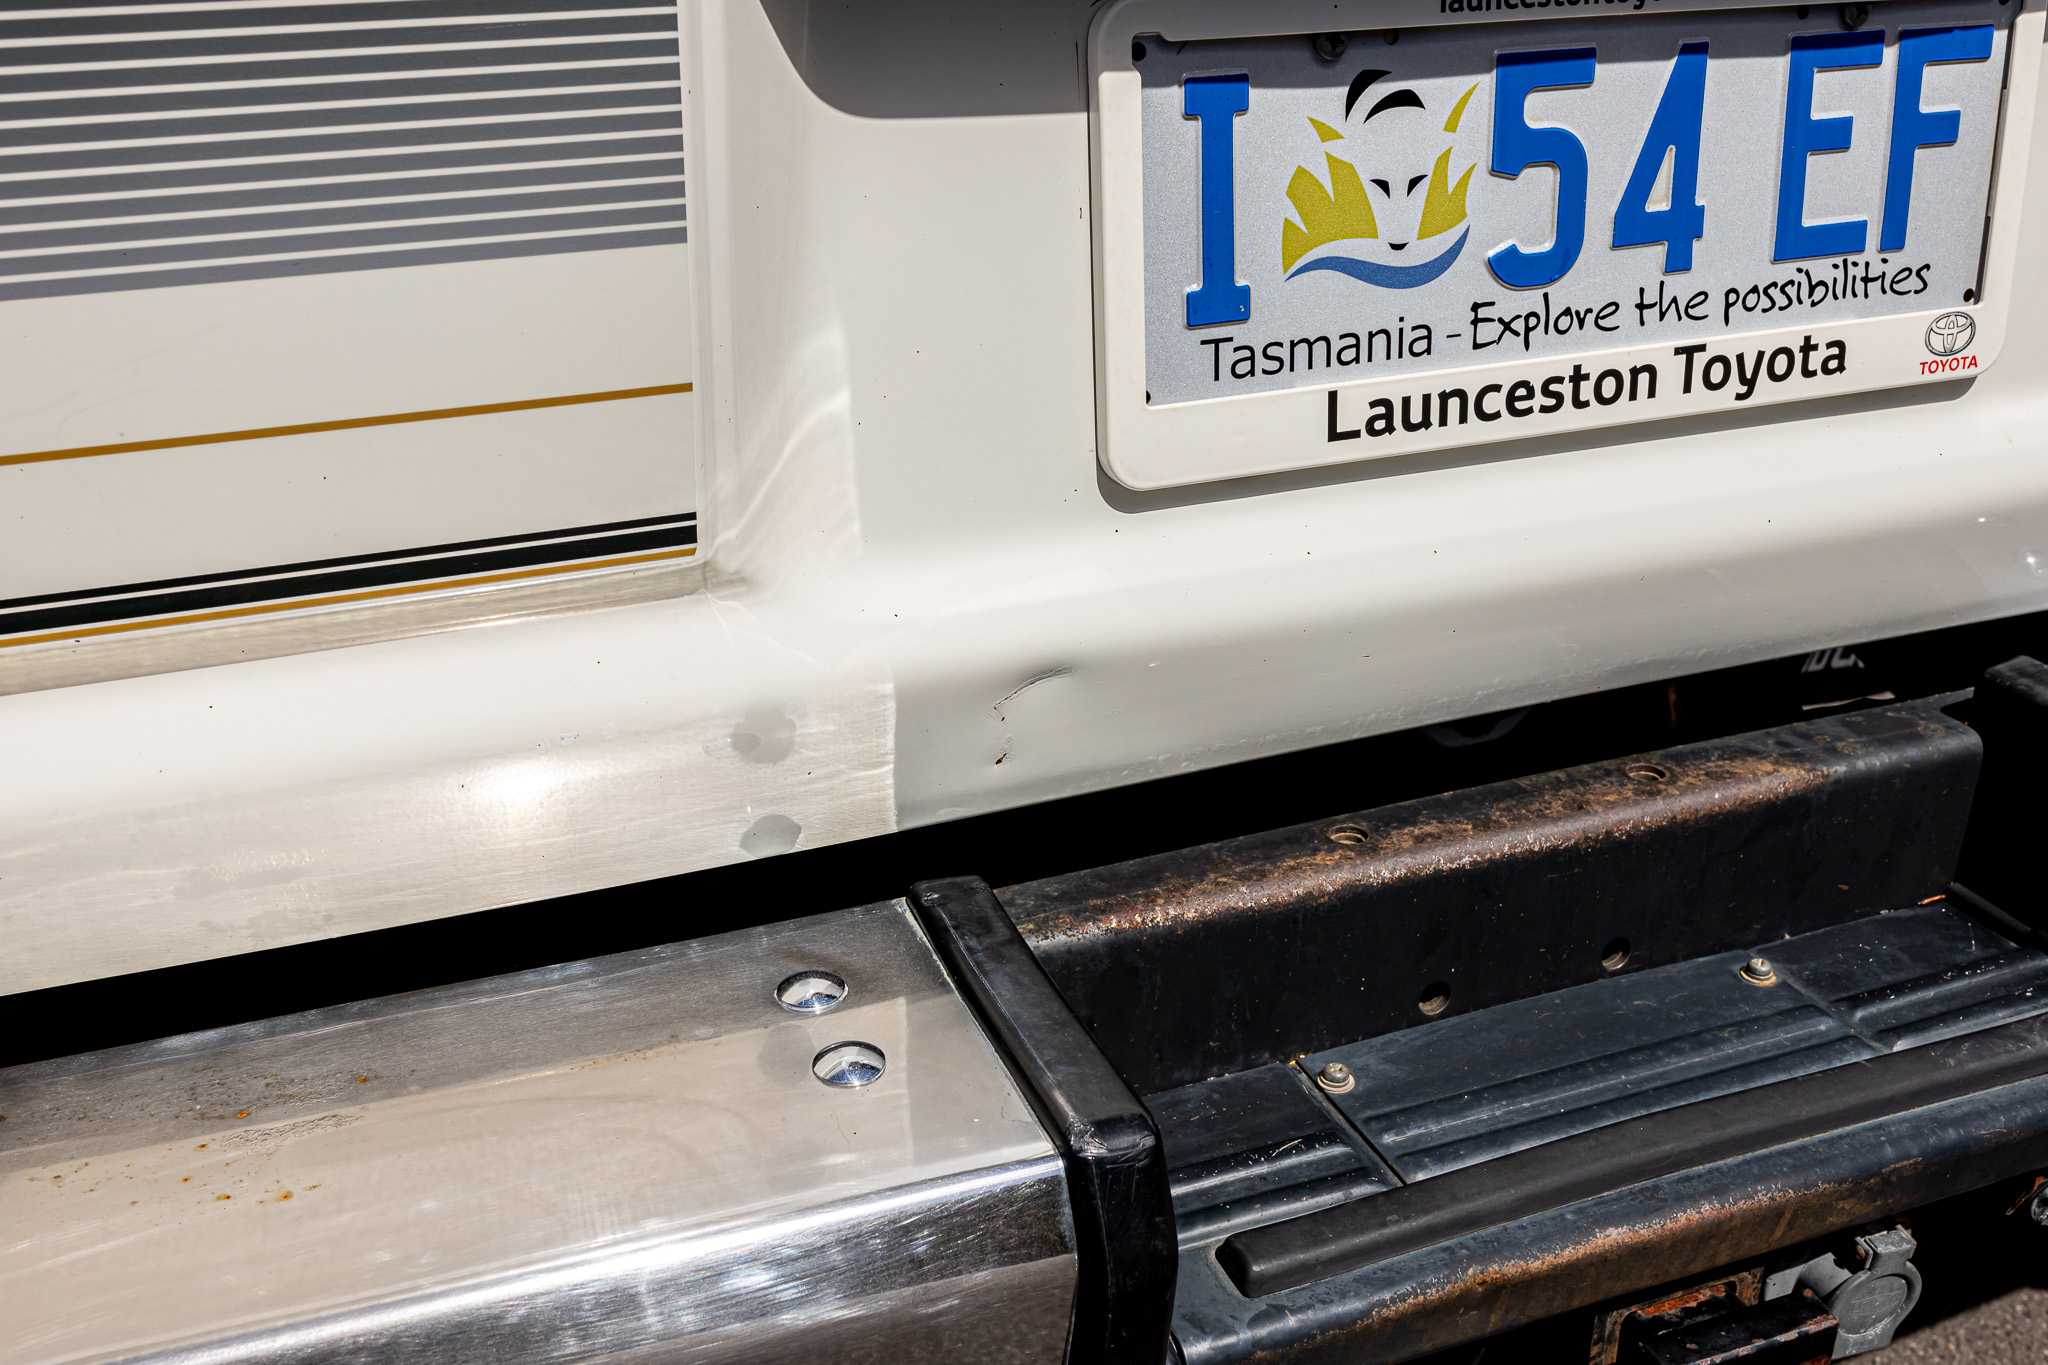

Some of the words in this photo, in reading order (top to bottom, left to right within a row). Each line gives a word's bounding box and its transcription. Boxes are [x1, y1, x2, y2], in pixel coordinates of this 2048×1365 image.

[1487, 40, 1709, 290] 54
[1773, 23, 1996, 263] EF
[1199, 316, 1433, 382] Tasmania
[1469, 291, 1620, 352] Explore
[1634, 280, 1709, 327] the
[1723, 257, 1931, 327] possibilities
[1919, 355, 1978, 375] TOYOTA
[1327, 363, 1658, 443] Launceston
[1673, 334, 1847, 401] Toyota
